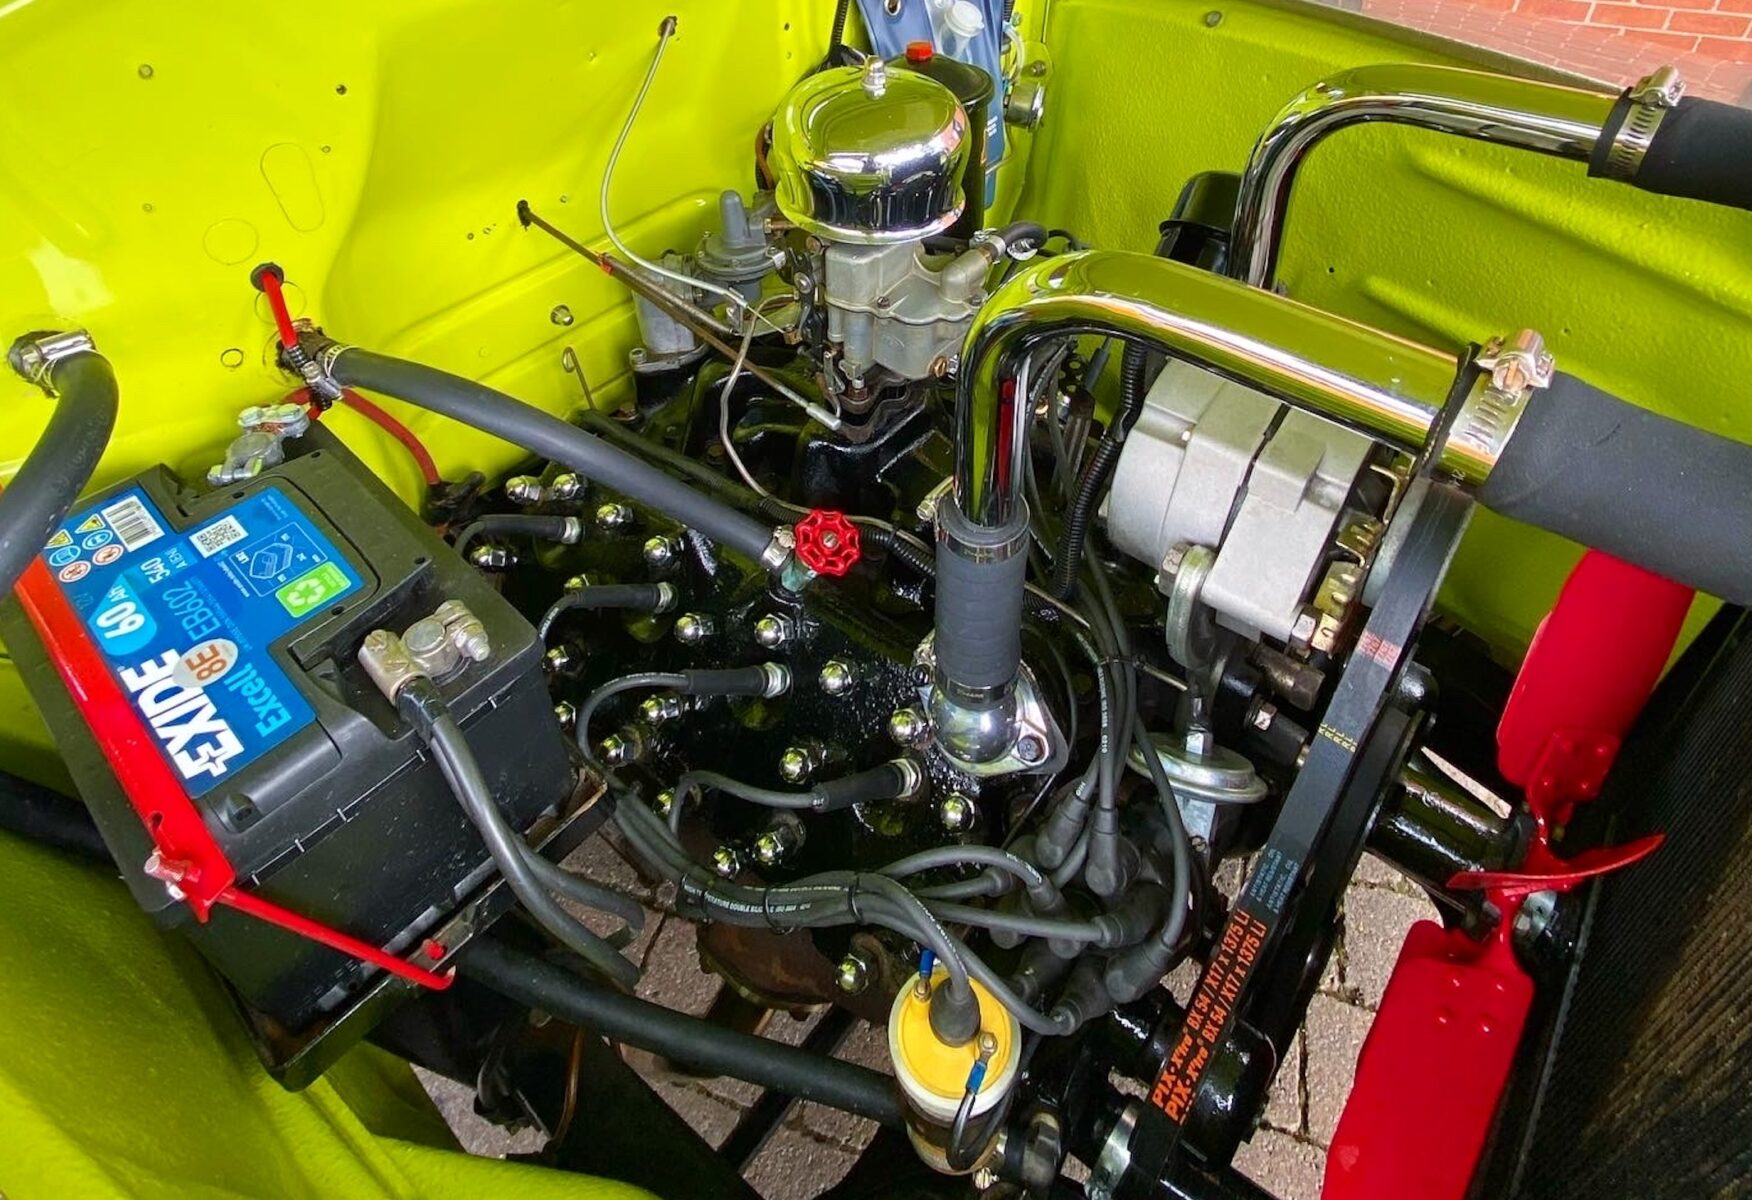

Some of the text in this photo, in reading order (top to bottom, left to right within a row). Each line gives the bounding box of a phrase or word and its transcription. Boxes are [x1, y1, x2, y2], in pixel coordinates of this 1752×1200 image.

[140, 557, 171, 584] 540
[96, 584, 145, 639] 60 Ah
[162, 580, 222, 642] EB602
[185, 644, 228, 682] 8E
[119, 648, 245, 780] EXIDE
[223, 662, 293, 738] Excell
[1221, 922, 1244, 955] 1375
[1237, 934, 1261, 967] 1375
[1204, 961, 1225, 990] X17
[1221, 973, 1241, 1003] X17
[1186, 1005, 1204, 1031] BX
[1194, 993, 1212, 1013] 54
[1210, 1004, 1228, 1026] 54
[1201, 1020, 1220, 1043] BX
